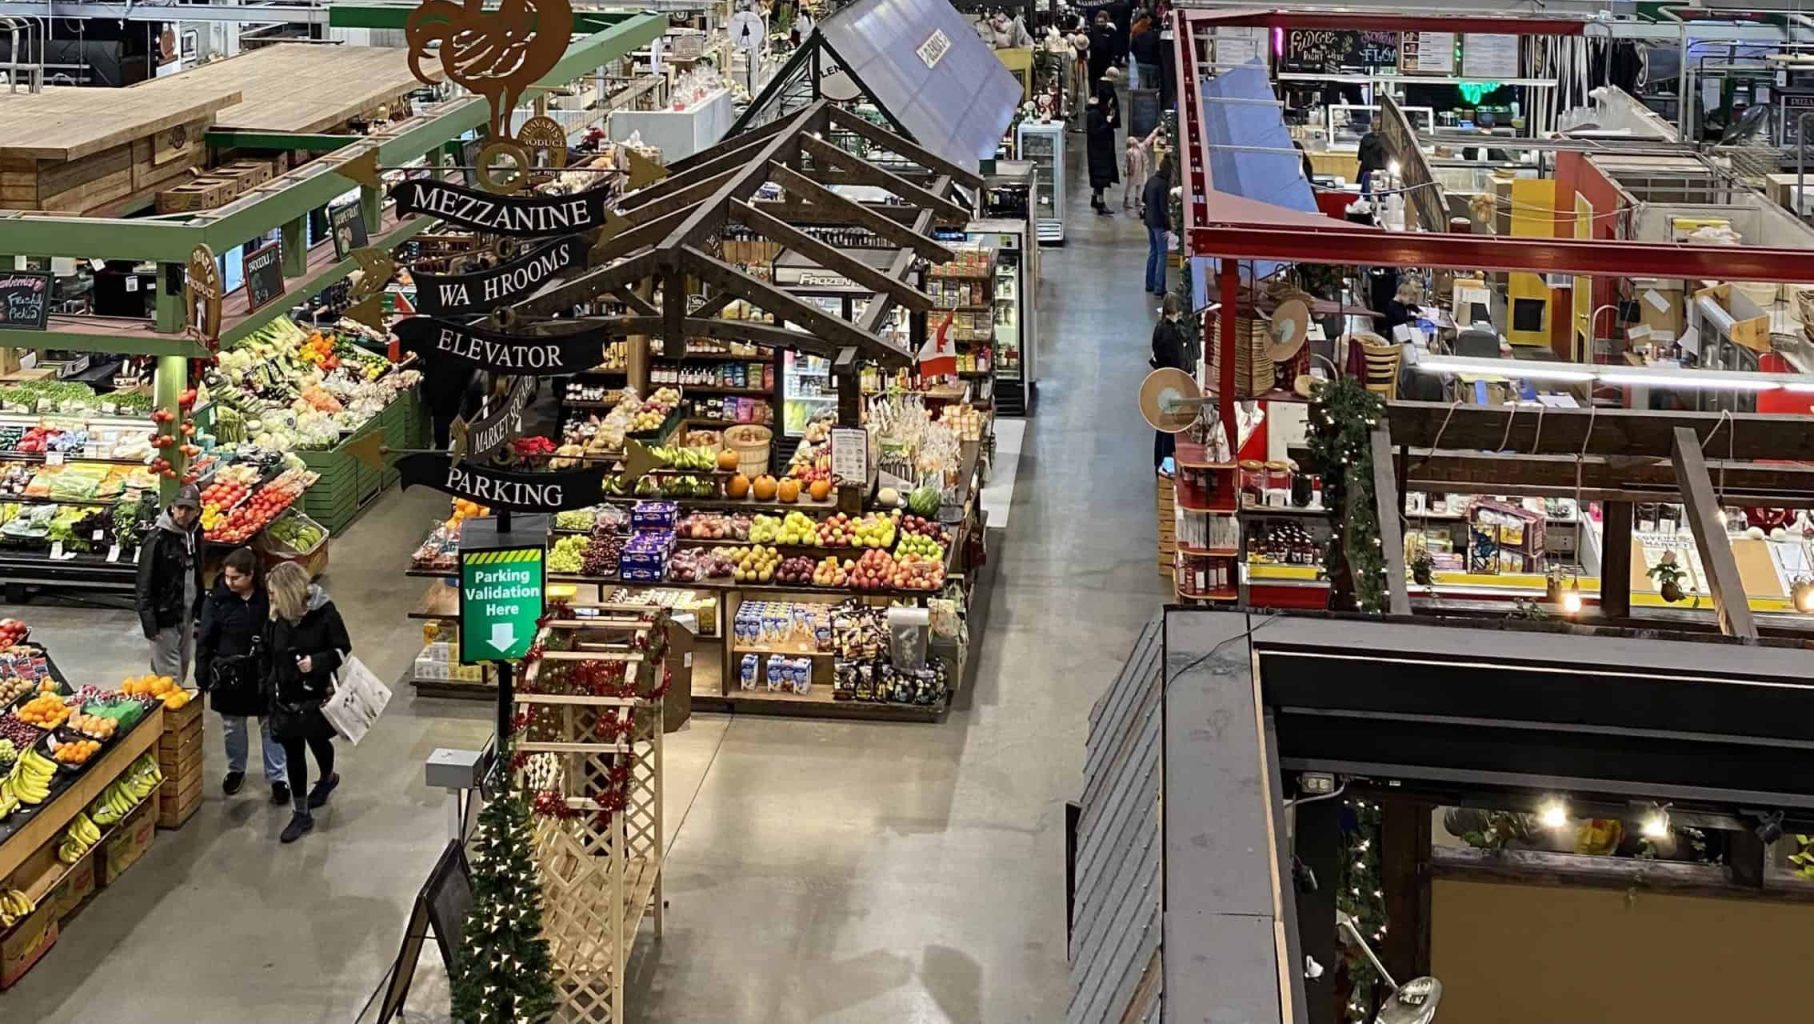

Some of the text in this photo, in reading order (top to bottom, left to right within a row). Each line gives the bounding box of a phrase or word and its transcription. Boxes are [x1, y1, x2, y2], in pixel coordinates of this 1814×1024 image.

[411, 184, 591, 231] MEZZANINE
[799, 273, 852, 286] FROZEN
[436, 328, 564, 368] ELEVATOR
[474, 375, 533, 455] MARKET SQUARE
[445, 466, 564, 507] PARKING
[475, 568, 531, 584] Parking
[465, 585, 540, 601] Validation
[486, 603, 520, 616] Here
